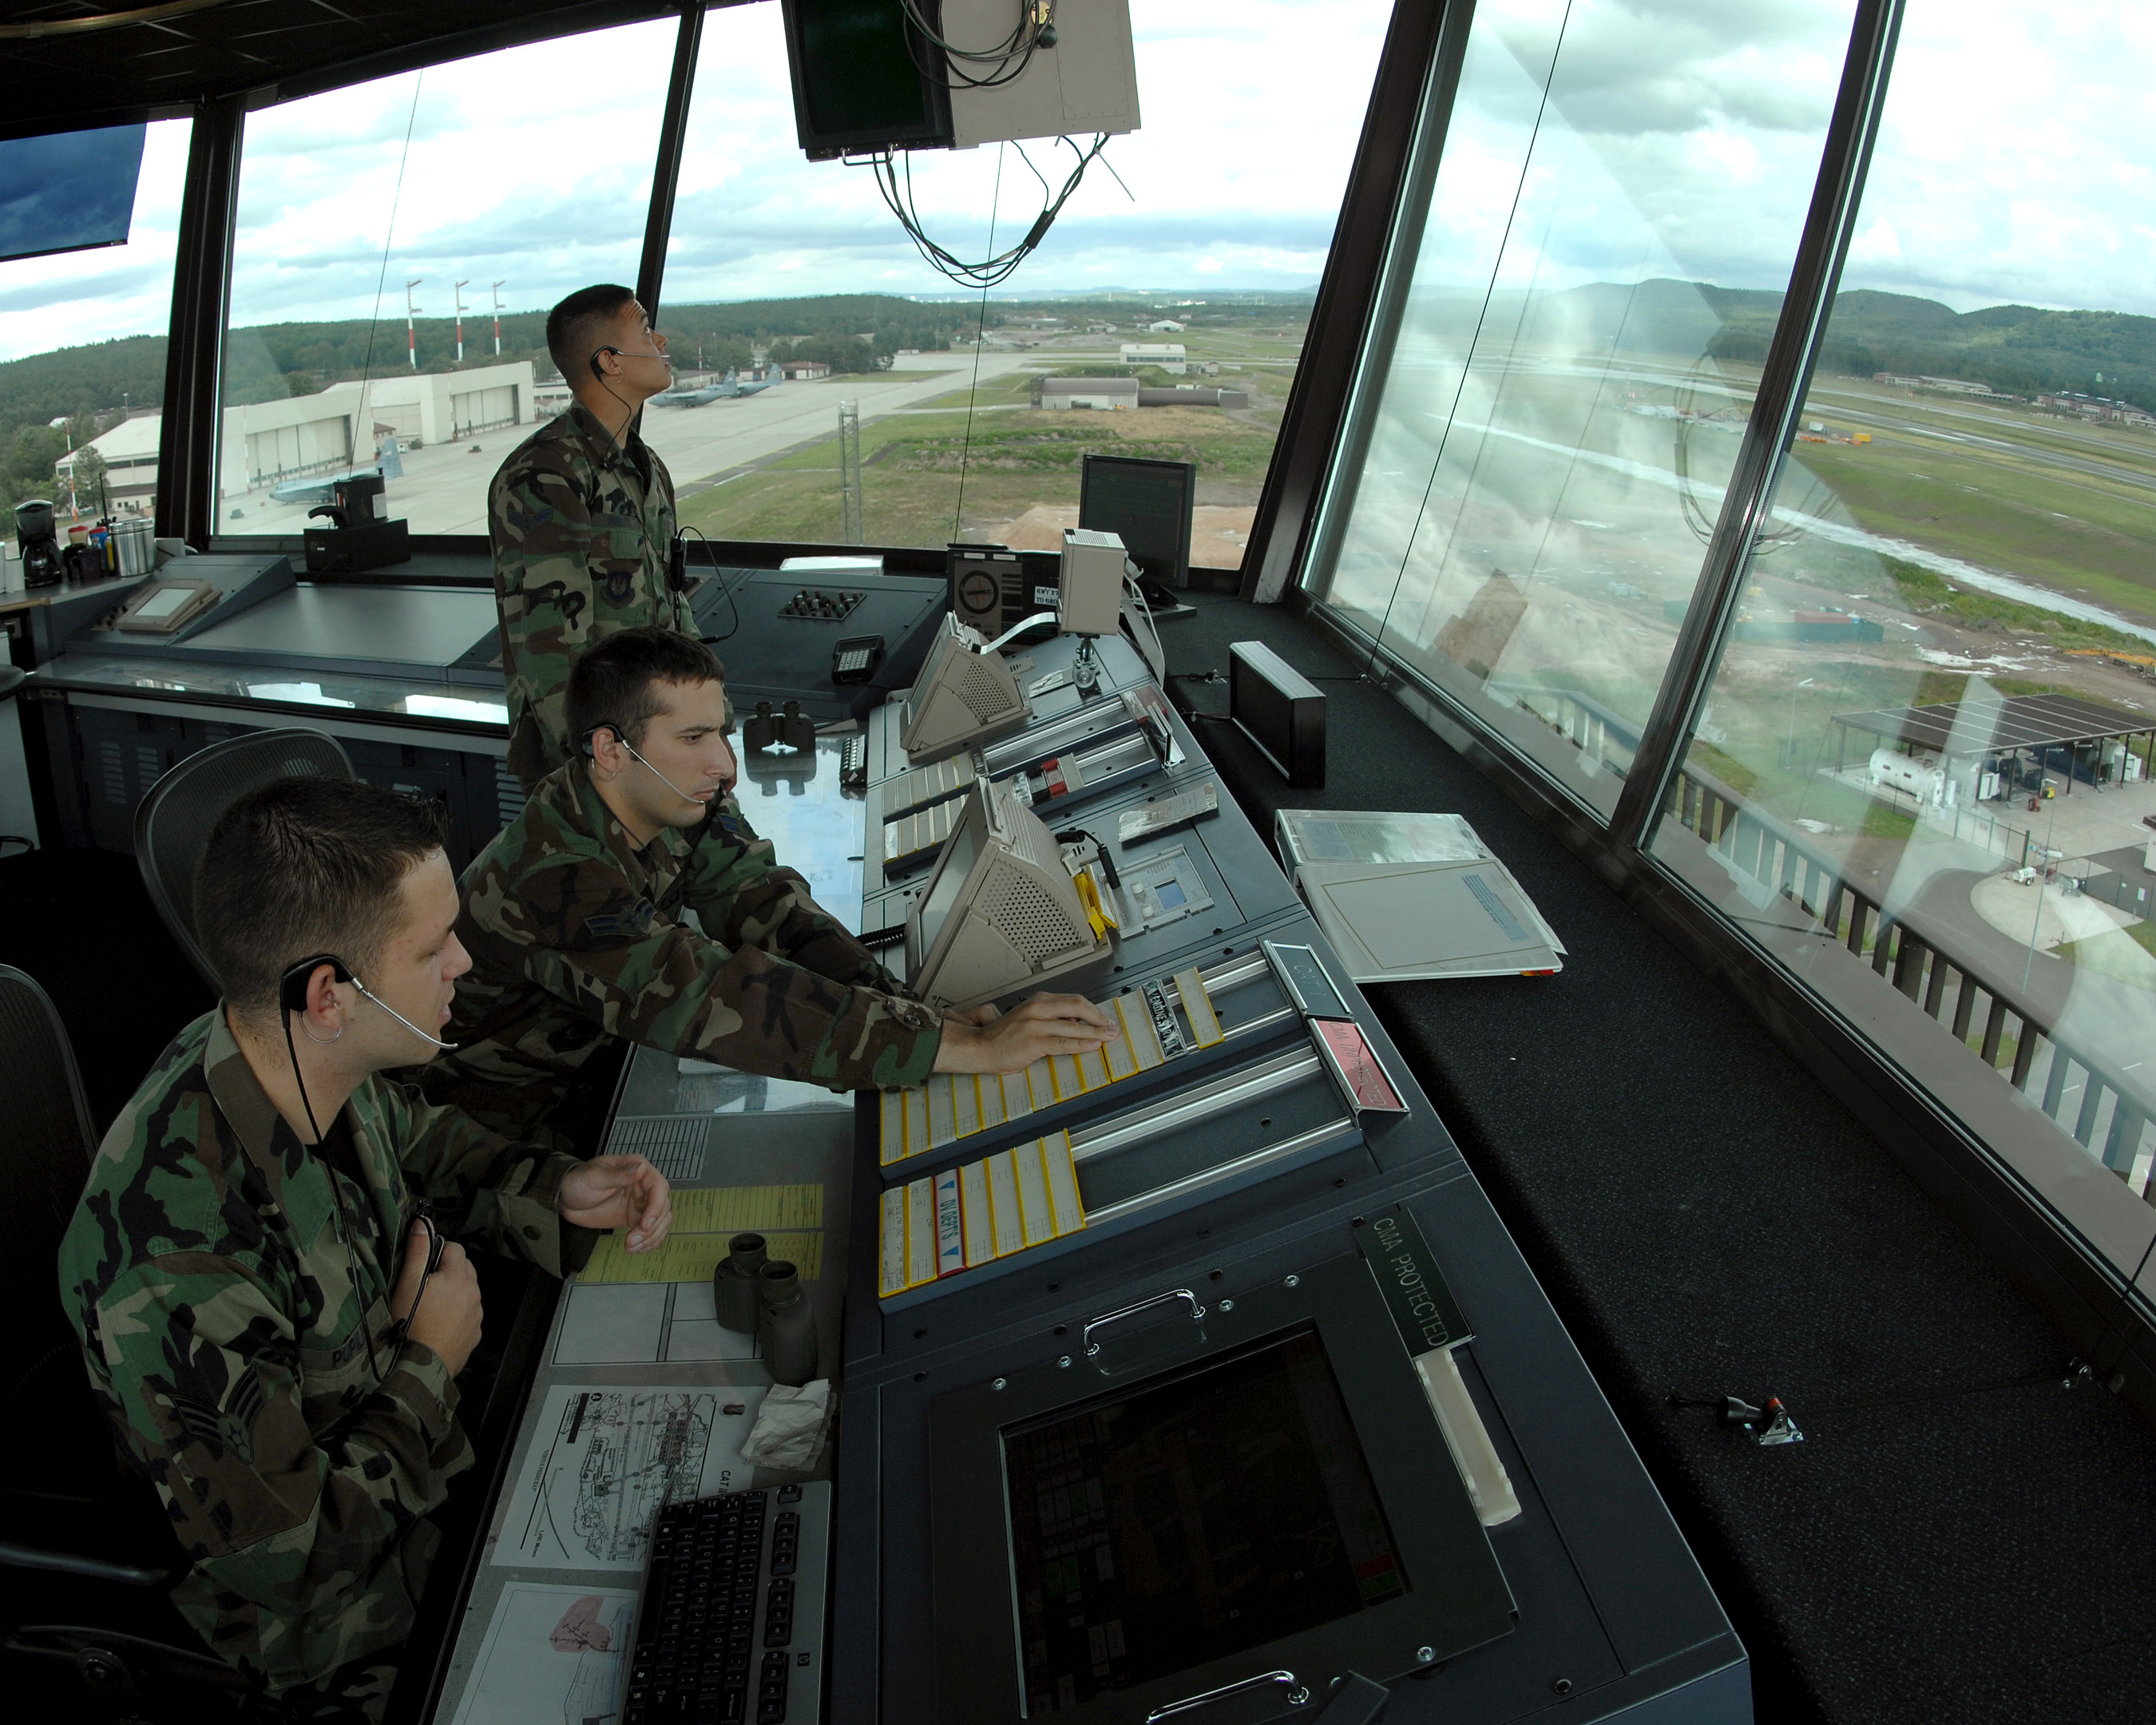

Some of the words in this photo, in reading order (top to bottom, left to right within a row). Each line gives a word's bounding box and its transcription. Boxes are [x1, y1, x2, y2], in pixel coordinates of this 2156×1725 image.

[1294, 965, 1322, 988] CAT
[1329, 1022, 1349, 1040] CMA
[1373, 1218, 1403, 1252] CMA
[1390, 1253, 1450, 1347] PROTECTED
[719, 1470, 731, 1487] CAT
